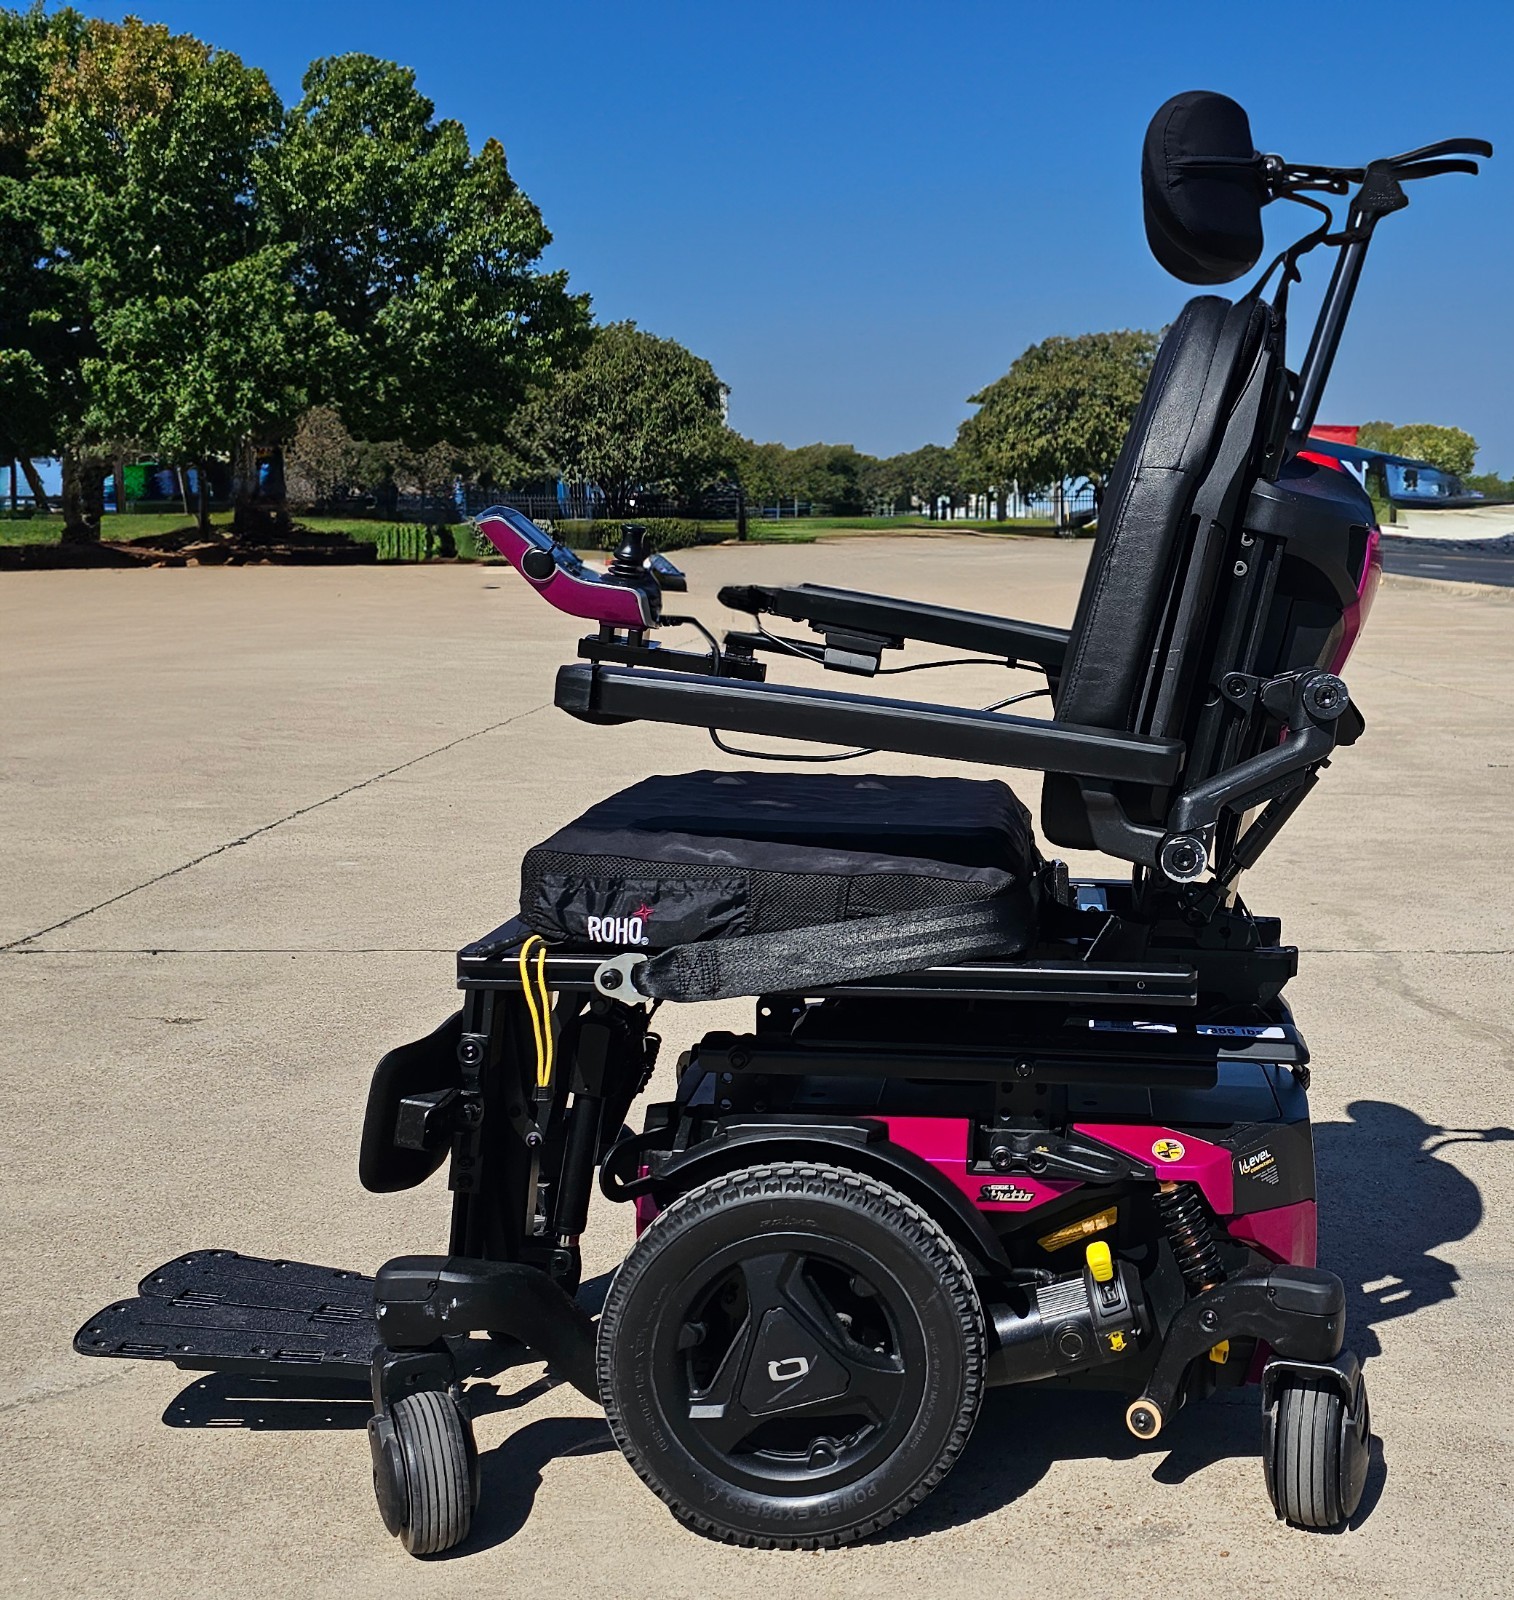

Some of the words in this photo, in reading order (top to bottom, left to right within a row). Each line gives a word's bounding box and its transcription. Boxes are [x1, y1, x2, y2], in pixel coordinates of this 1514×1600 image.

[588, 916, 643, 945] ROHO
[981, 1186, 1034, 1202] Stretto
[726, 1498, 811, 1521] EXPRESS
[818, 1481, 880, 1518] POWER
